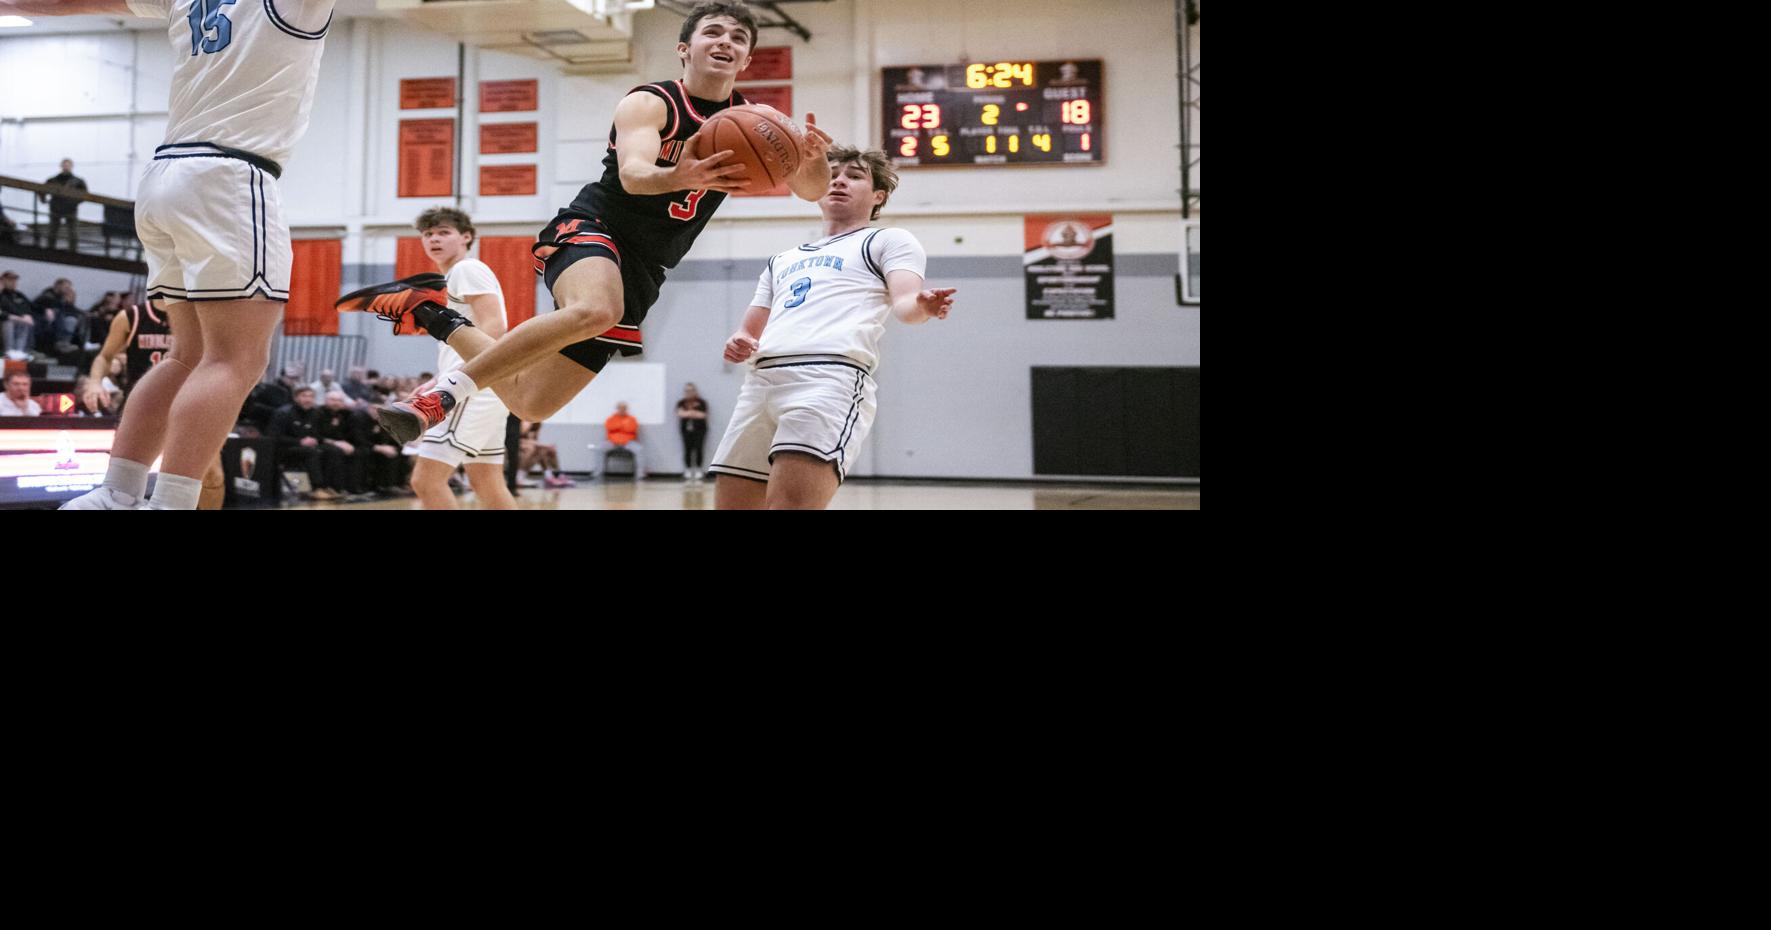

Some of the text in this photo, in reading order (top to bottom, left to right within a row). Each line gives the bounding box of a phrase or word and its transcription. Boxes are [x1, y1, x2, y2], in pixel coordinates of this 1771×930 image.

[187, 0, 236, 56] 15
[965, 62, 1034, 89] 6:24
[1043, 87, 1087, 100] GUEST
[901, 103, 941, 129] 23
[980, 103, 1001, 126] 2
[1060, 98, 1091, 125] 18
[900, 135, 918, 157] 2
[931, 134, 951, 157] 5
[1031, 132, 1052, 153] 4
[1080, 132, 1091, 151] 1
[667, 189, 708, 222] 3
[783, 276, 812, 309] 3
